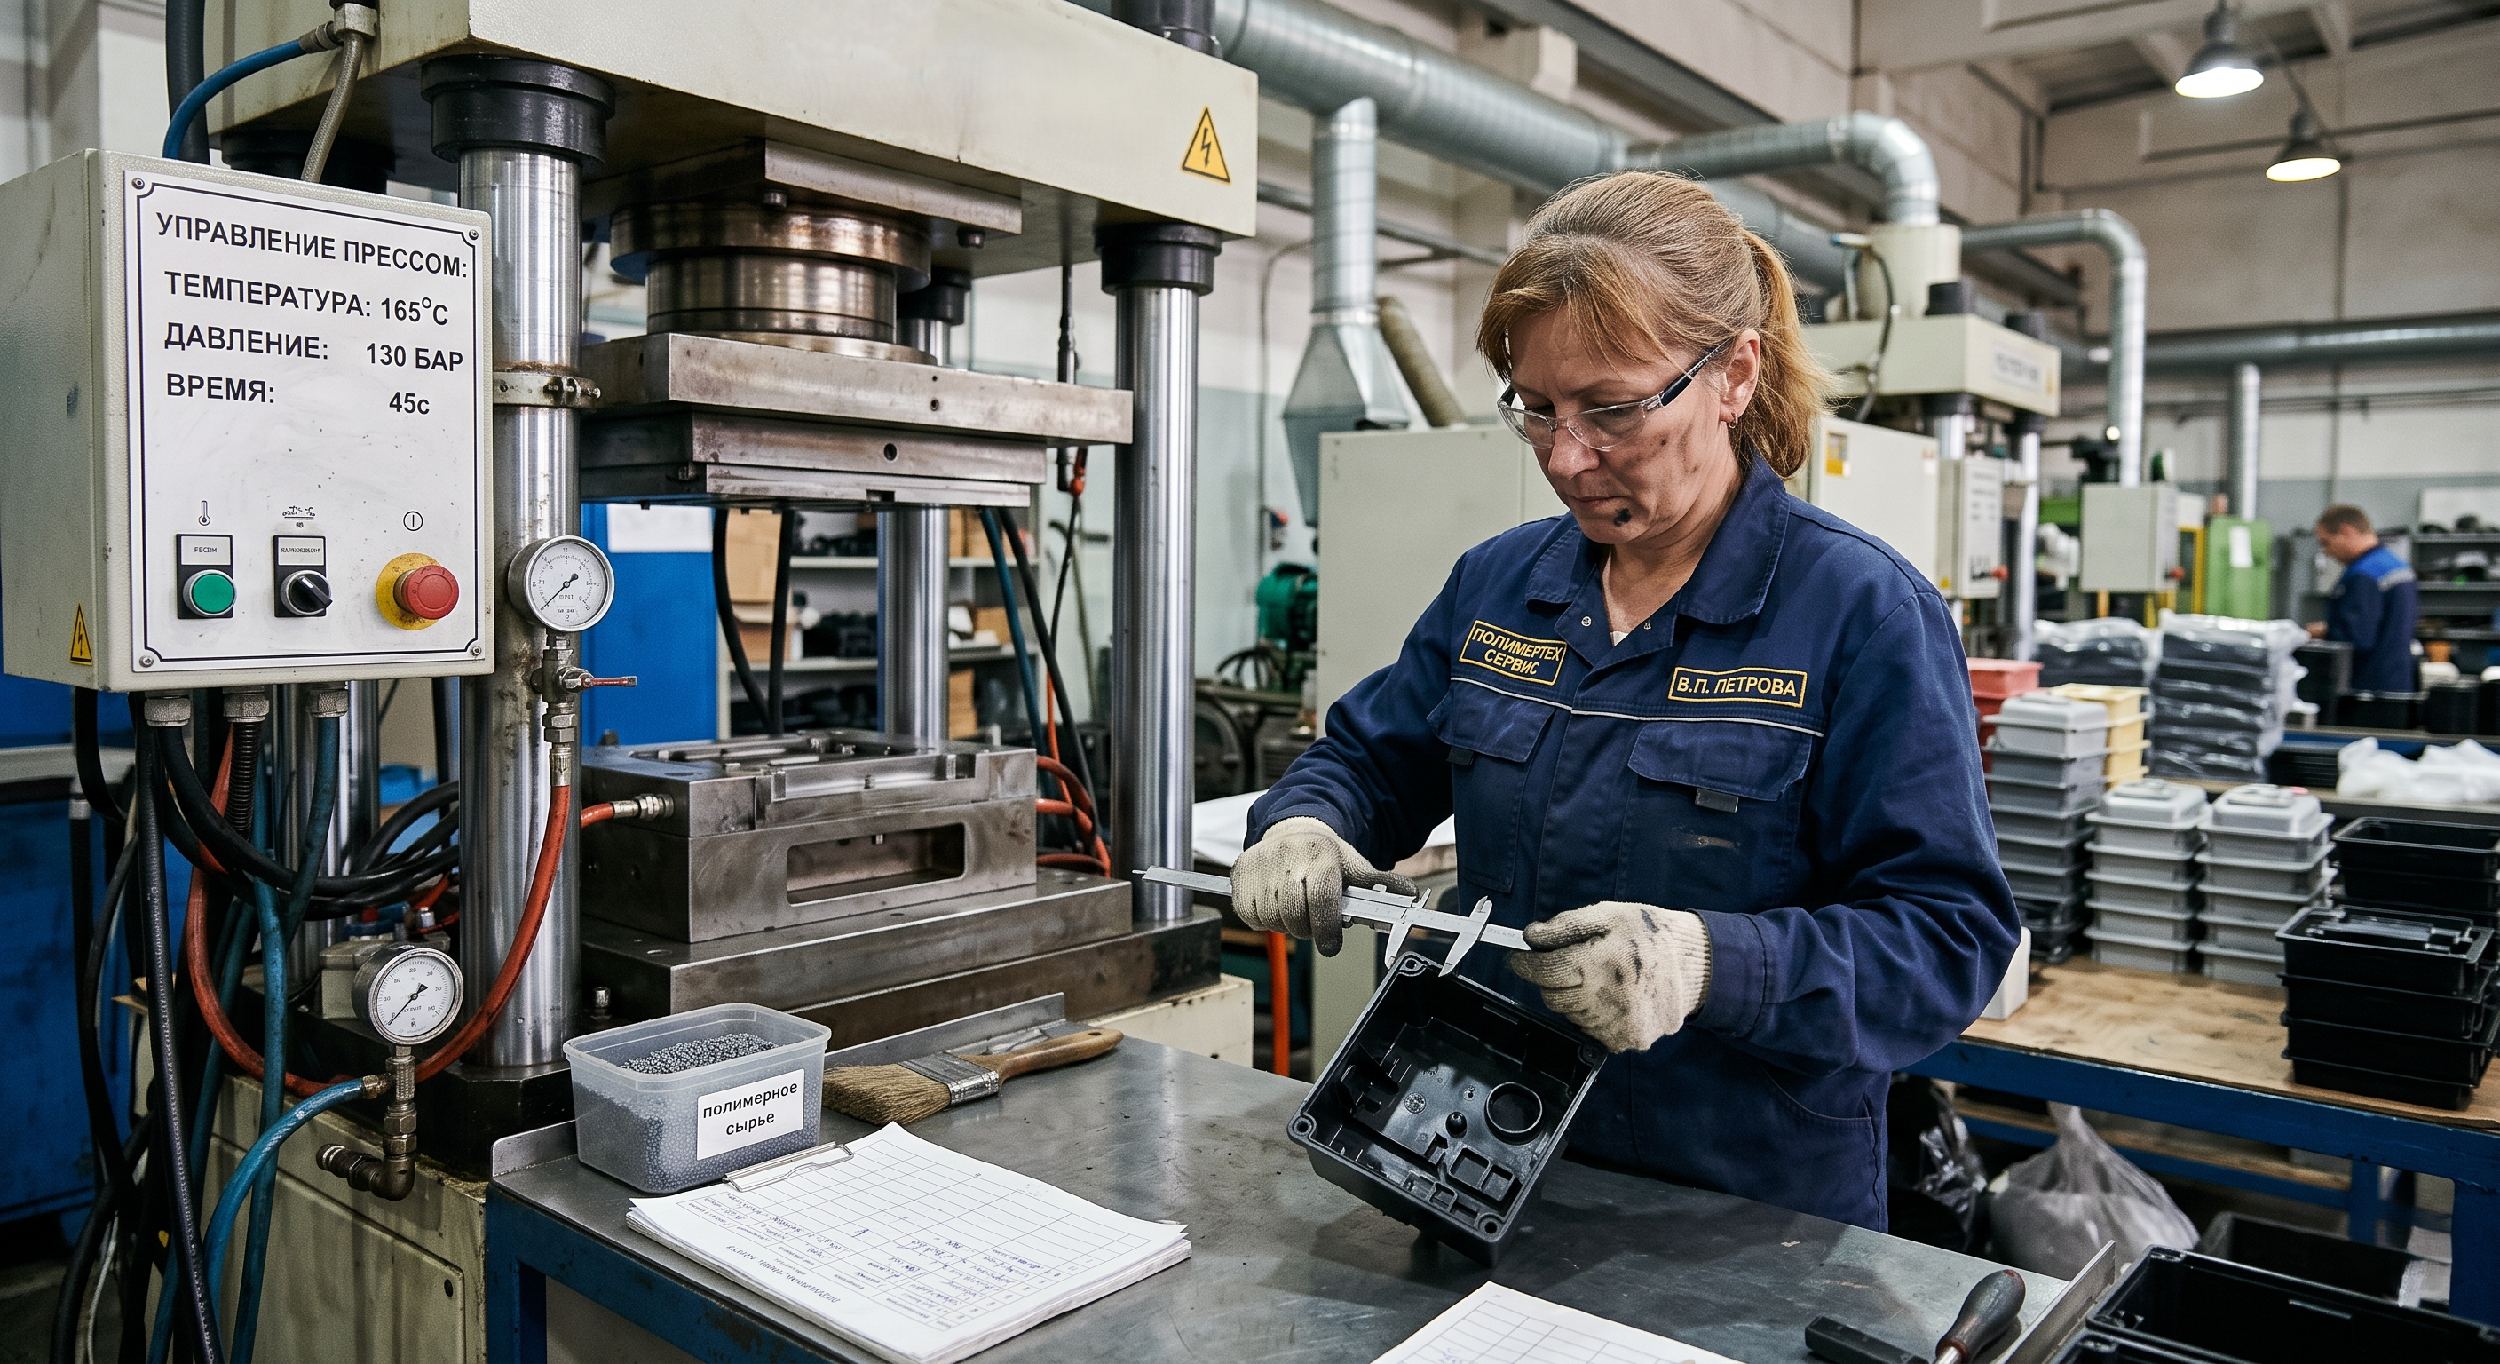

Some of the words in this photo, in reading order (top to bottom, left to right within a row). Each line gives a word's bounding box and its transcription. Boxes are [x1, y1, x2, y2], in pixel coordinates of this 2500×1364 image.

[156, 211, 336, 260] УПРАВЛЕНИЕ
[344, 240, 467, 278] ПРЕССОМ:
[165, 271, 371, 317] ТЕМПЕРАТУРА:
[164, 321, 328, 360] ДАВЛЕНИЕ:
[367, 343, 407, 368] 130
[415, 347, 464, 372] БАР
[167, 372, 274, 404] ВРЕМЯ:
[389, 391, 430, 415] 45с
[1472, 628, 1563, 661] ПОЛИМЕРТЕХ
[1484, 649, 1540, 675] СЕРВИС
[1677, 677, 1710, 694] В.П.
[1713, 676, 1796, 697] ПЕТРОВА
[703, 1082, 798, 1119] полимерное
[726, 1113, 775, 1135] сырье
